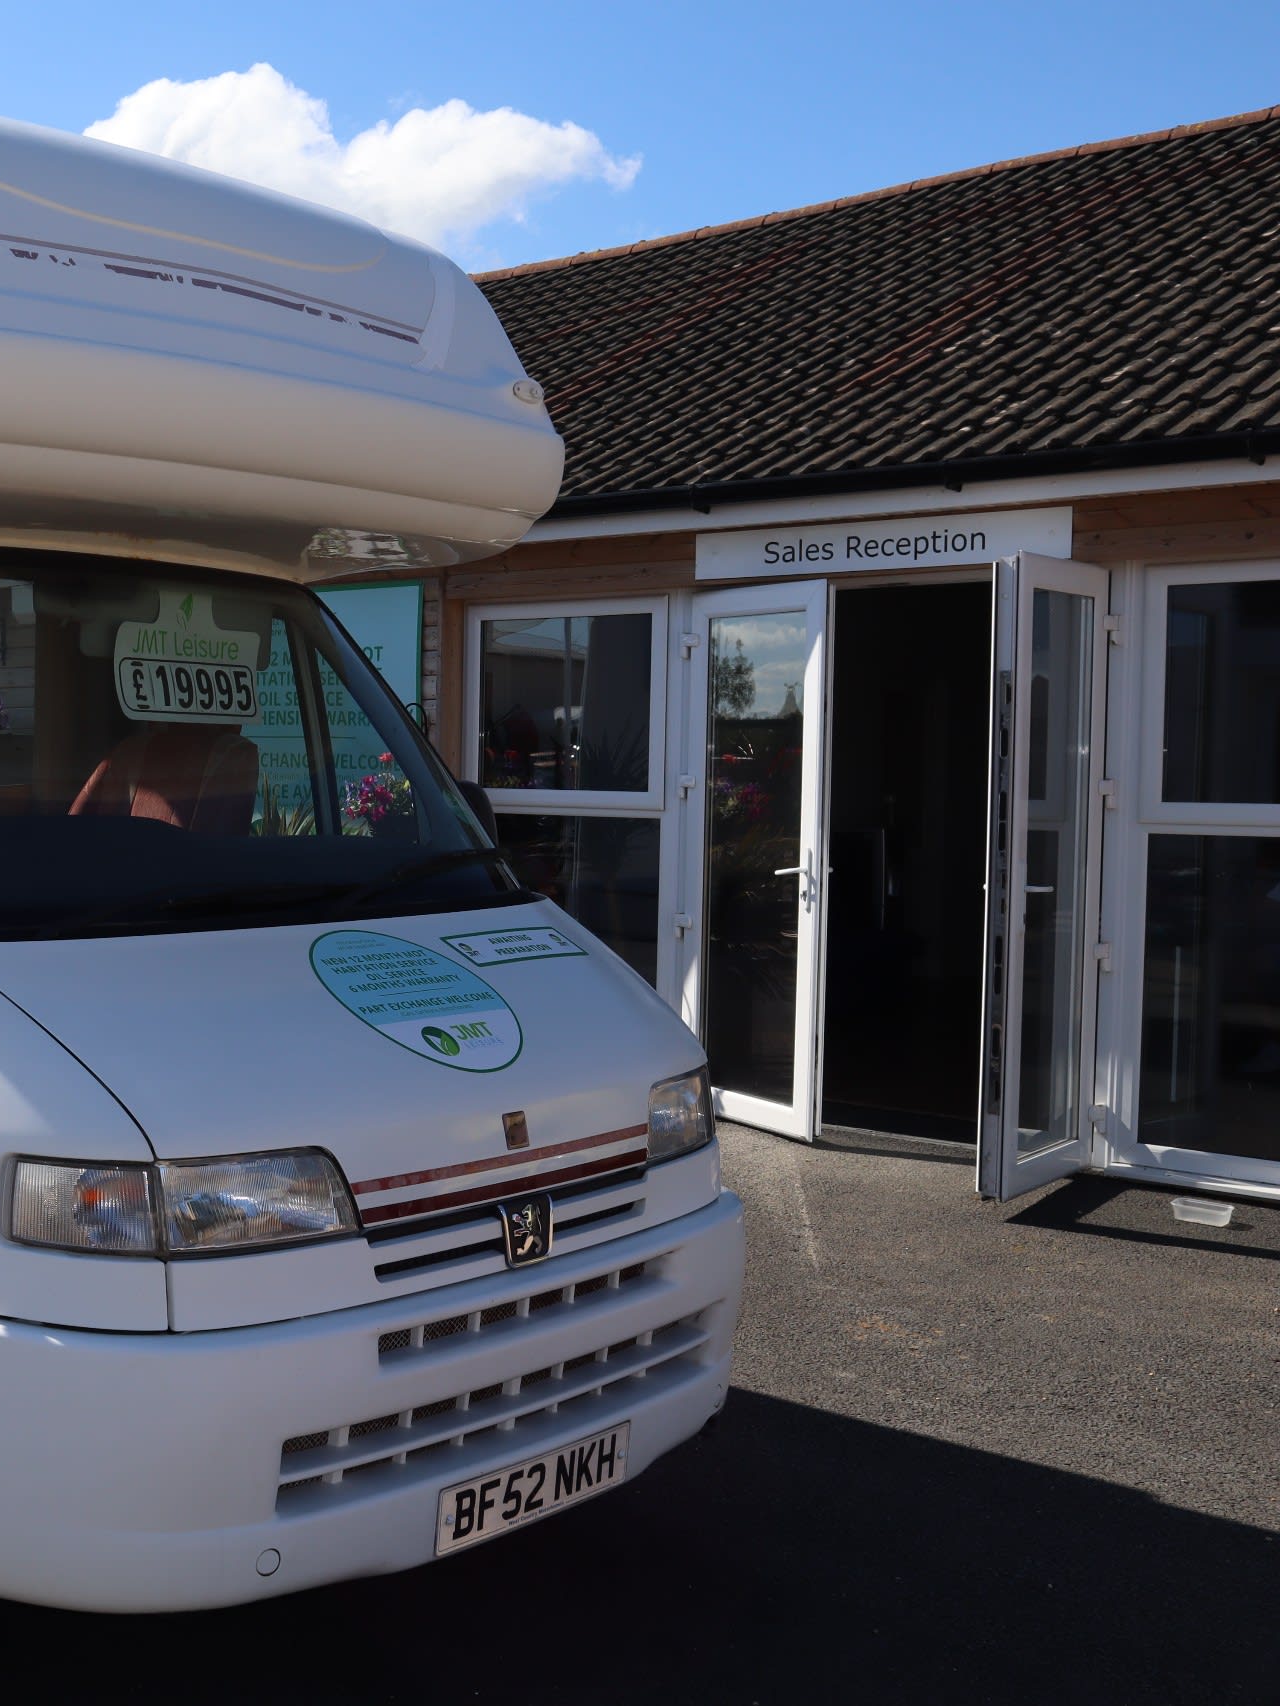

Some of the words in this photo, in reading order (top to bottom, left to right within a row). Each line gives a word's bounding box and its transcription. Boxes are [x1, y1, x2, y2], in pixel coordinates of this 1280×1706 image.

[764, 539, 834, 564] Sales
[846, 529, 986, 560] Reception
[132, 629, 168, 655] JMT
[174, 631, 239, 660] Leisure
[258, 691, 280, 706] OIL
[488, 934, 533, 945] AWAITING
[321, 956, 348, 966] NEW
[348, 955, 363, 964] 12
[361, 951, 402, 963] MONTH
[402, 949, 427, 959] MOT
[495, 943, 553, 956] PREPARATION
[331, 962, 399, 975] HABITATION
[399, 957, 439, 969] SERVICE
[366, 971, 388, 981] OIL
[387, 968, 427, 979] SERVICE
[349, 984, 358, 993] 6
[357, 979, 406, 992] MONTHS
[406, 974, 462, 987] WARRANTY
[358, 1003, 389, 1015] PART
[388, 995, 446, 1012] EXCHANGE
[444, 991, 495, 1004] WELCOME
[449, 1021, 493, 1040] JMT
[452, 1462, 546, 1540] BF52
[554, 1433, 617, 1501] NKH
